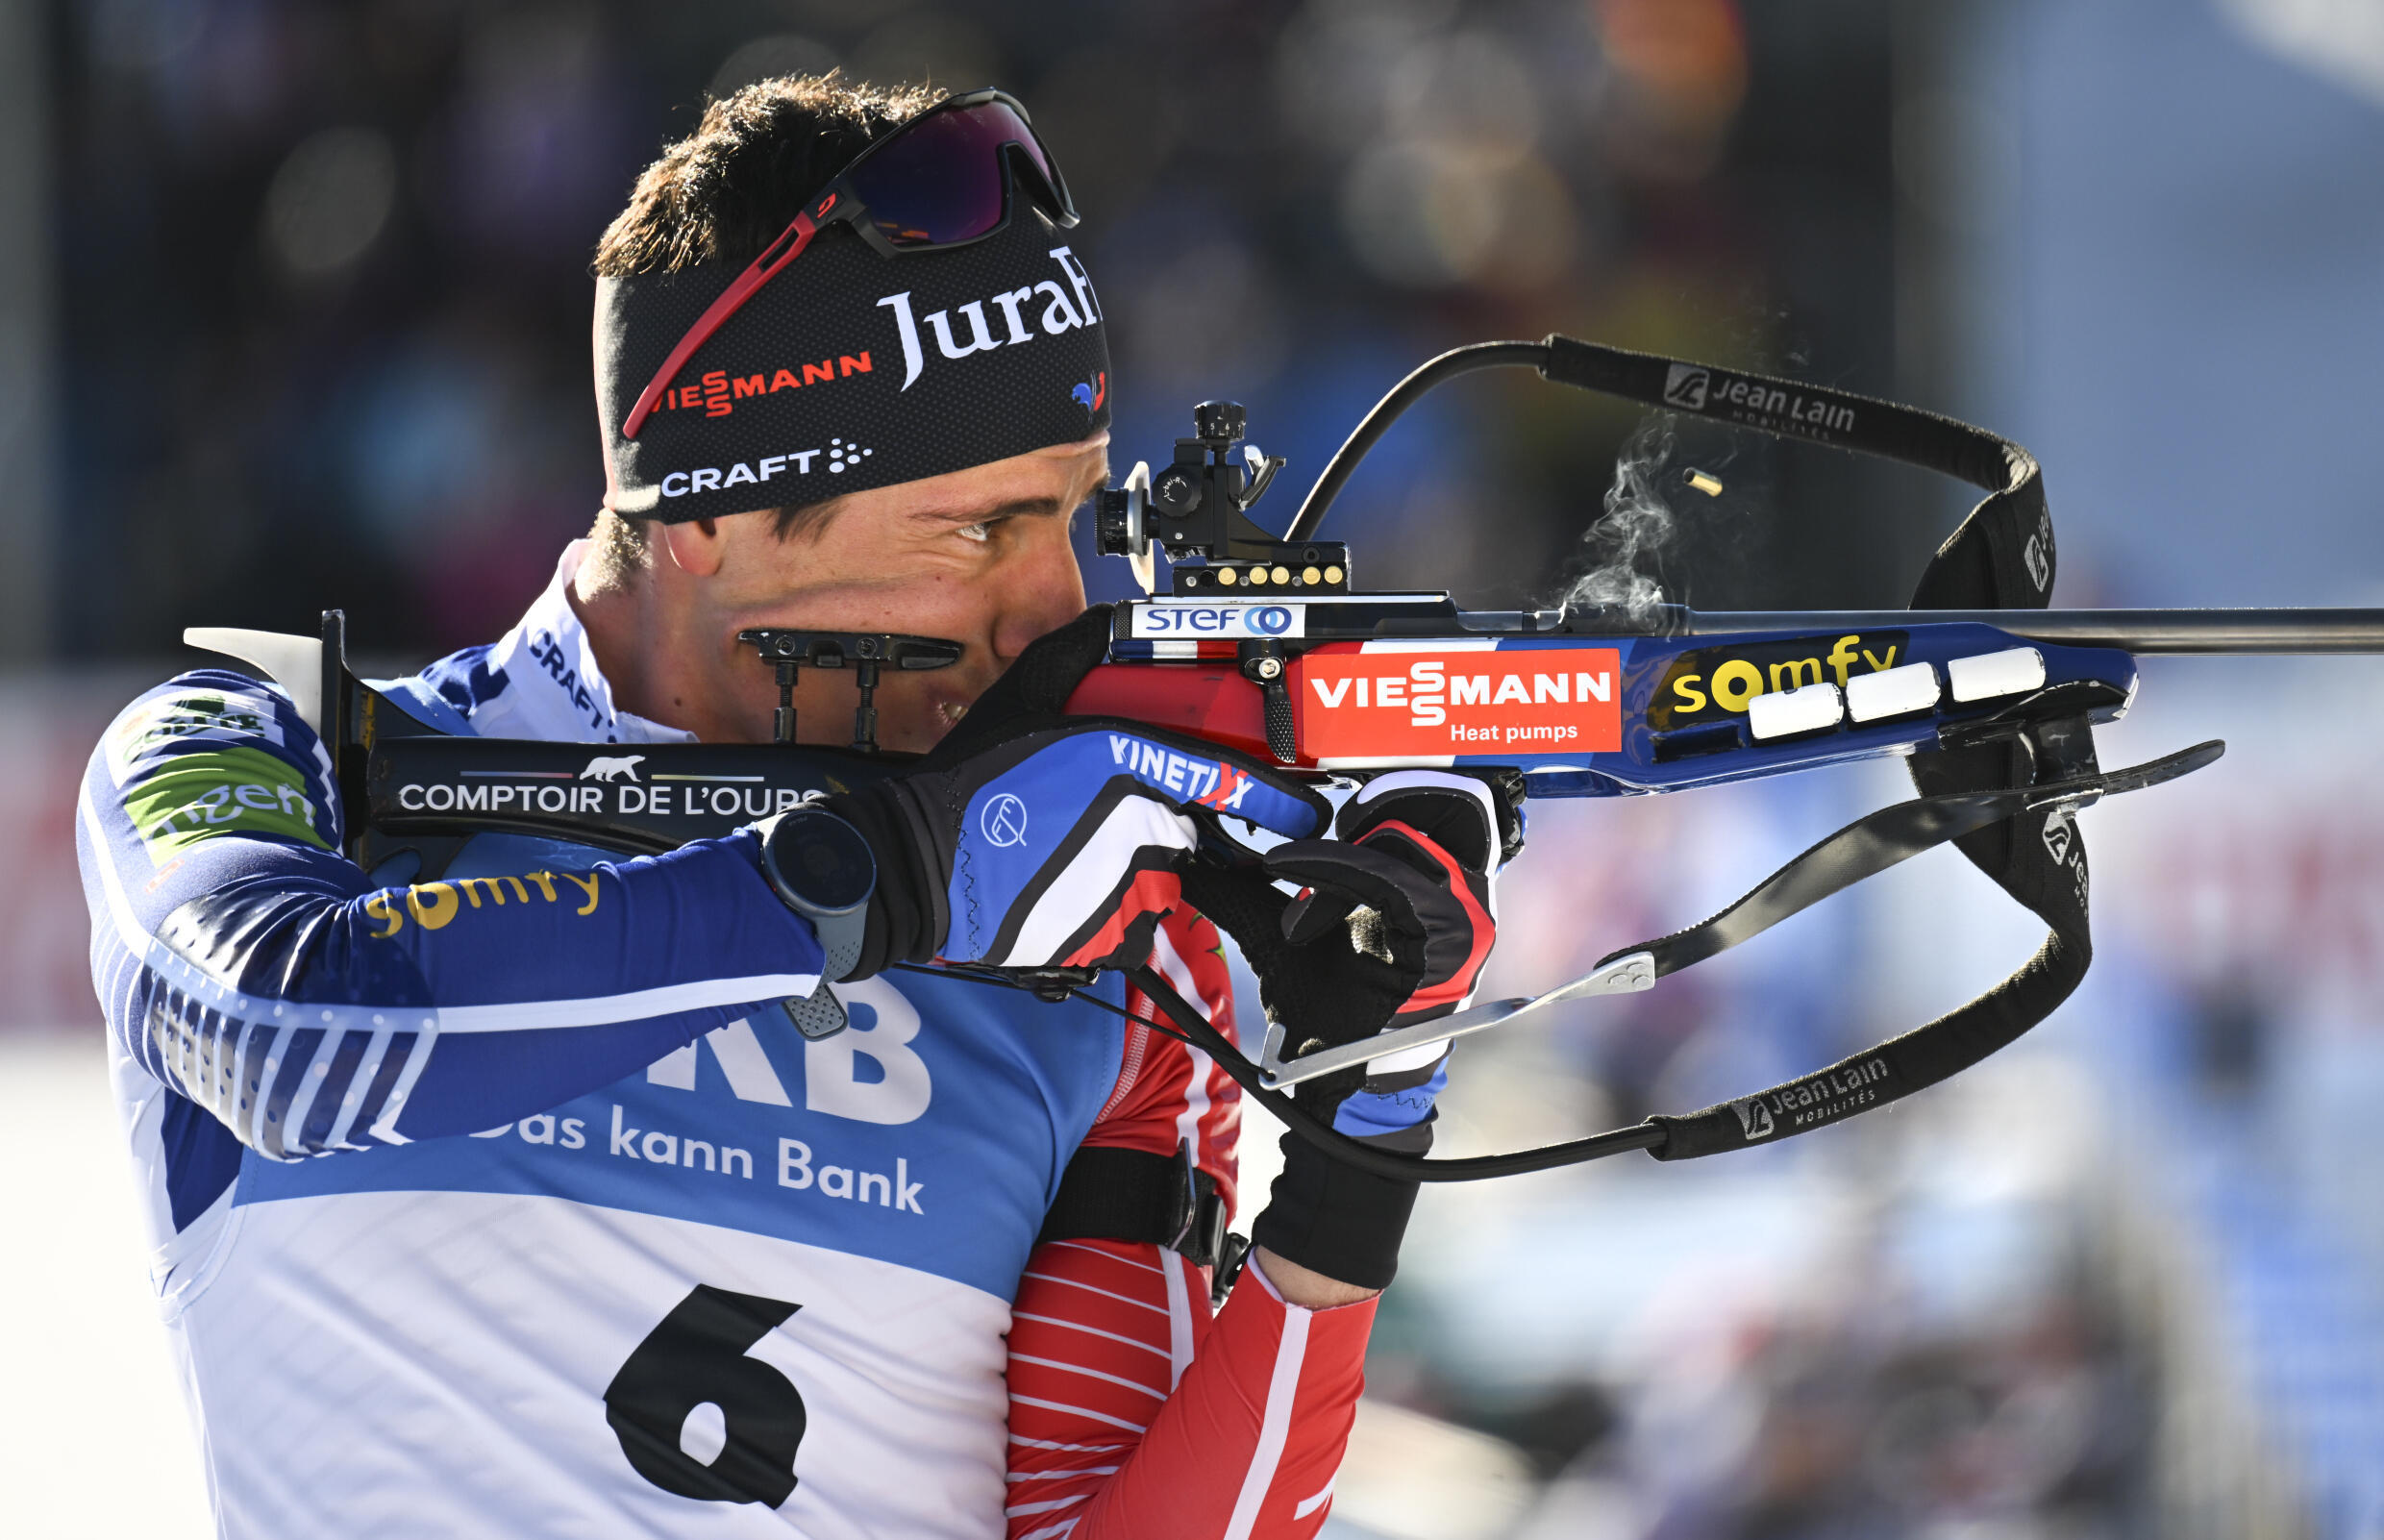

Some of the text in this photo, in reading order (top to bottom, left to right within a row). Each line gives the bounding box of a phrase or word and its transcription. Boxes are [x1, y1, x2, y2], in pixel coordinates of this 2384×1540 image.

[1713, 379, 1855, 433] Jean Lain
[660, 448, 821, 498] CRAFT
[530, 628, 603, 729] CRAFT
[1310, 660, 1611, 727] VIESSMANN
[1451, 724, 1578, 743] Heat pumps
[398, 783, 603, 814] COMPTOIR
[619, 785, 672, 815] DE
[1772, 1057, 1889, 1115] Jean Lain
[469, 1104, 925, 1215] as kann Bank
[602, 1282, 807, 1511] 6
